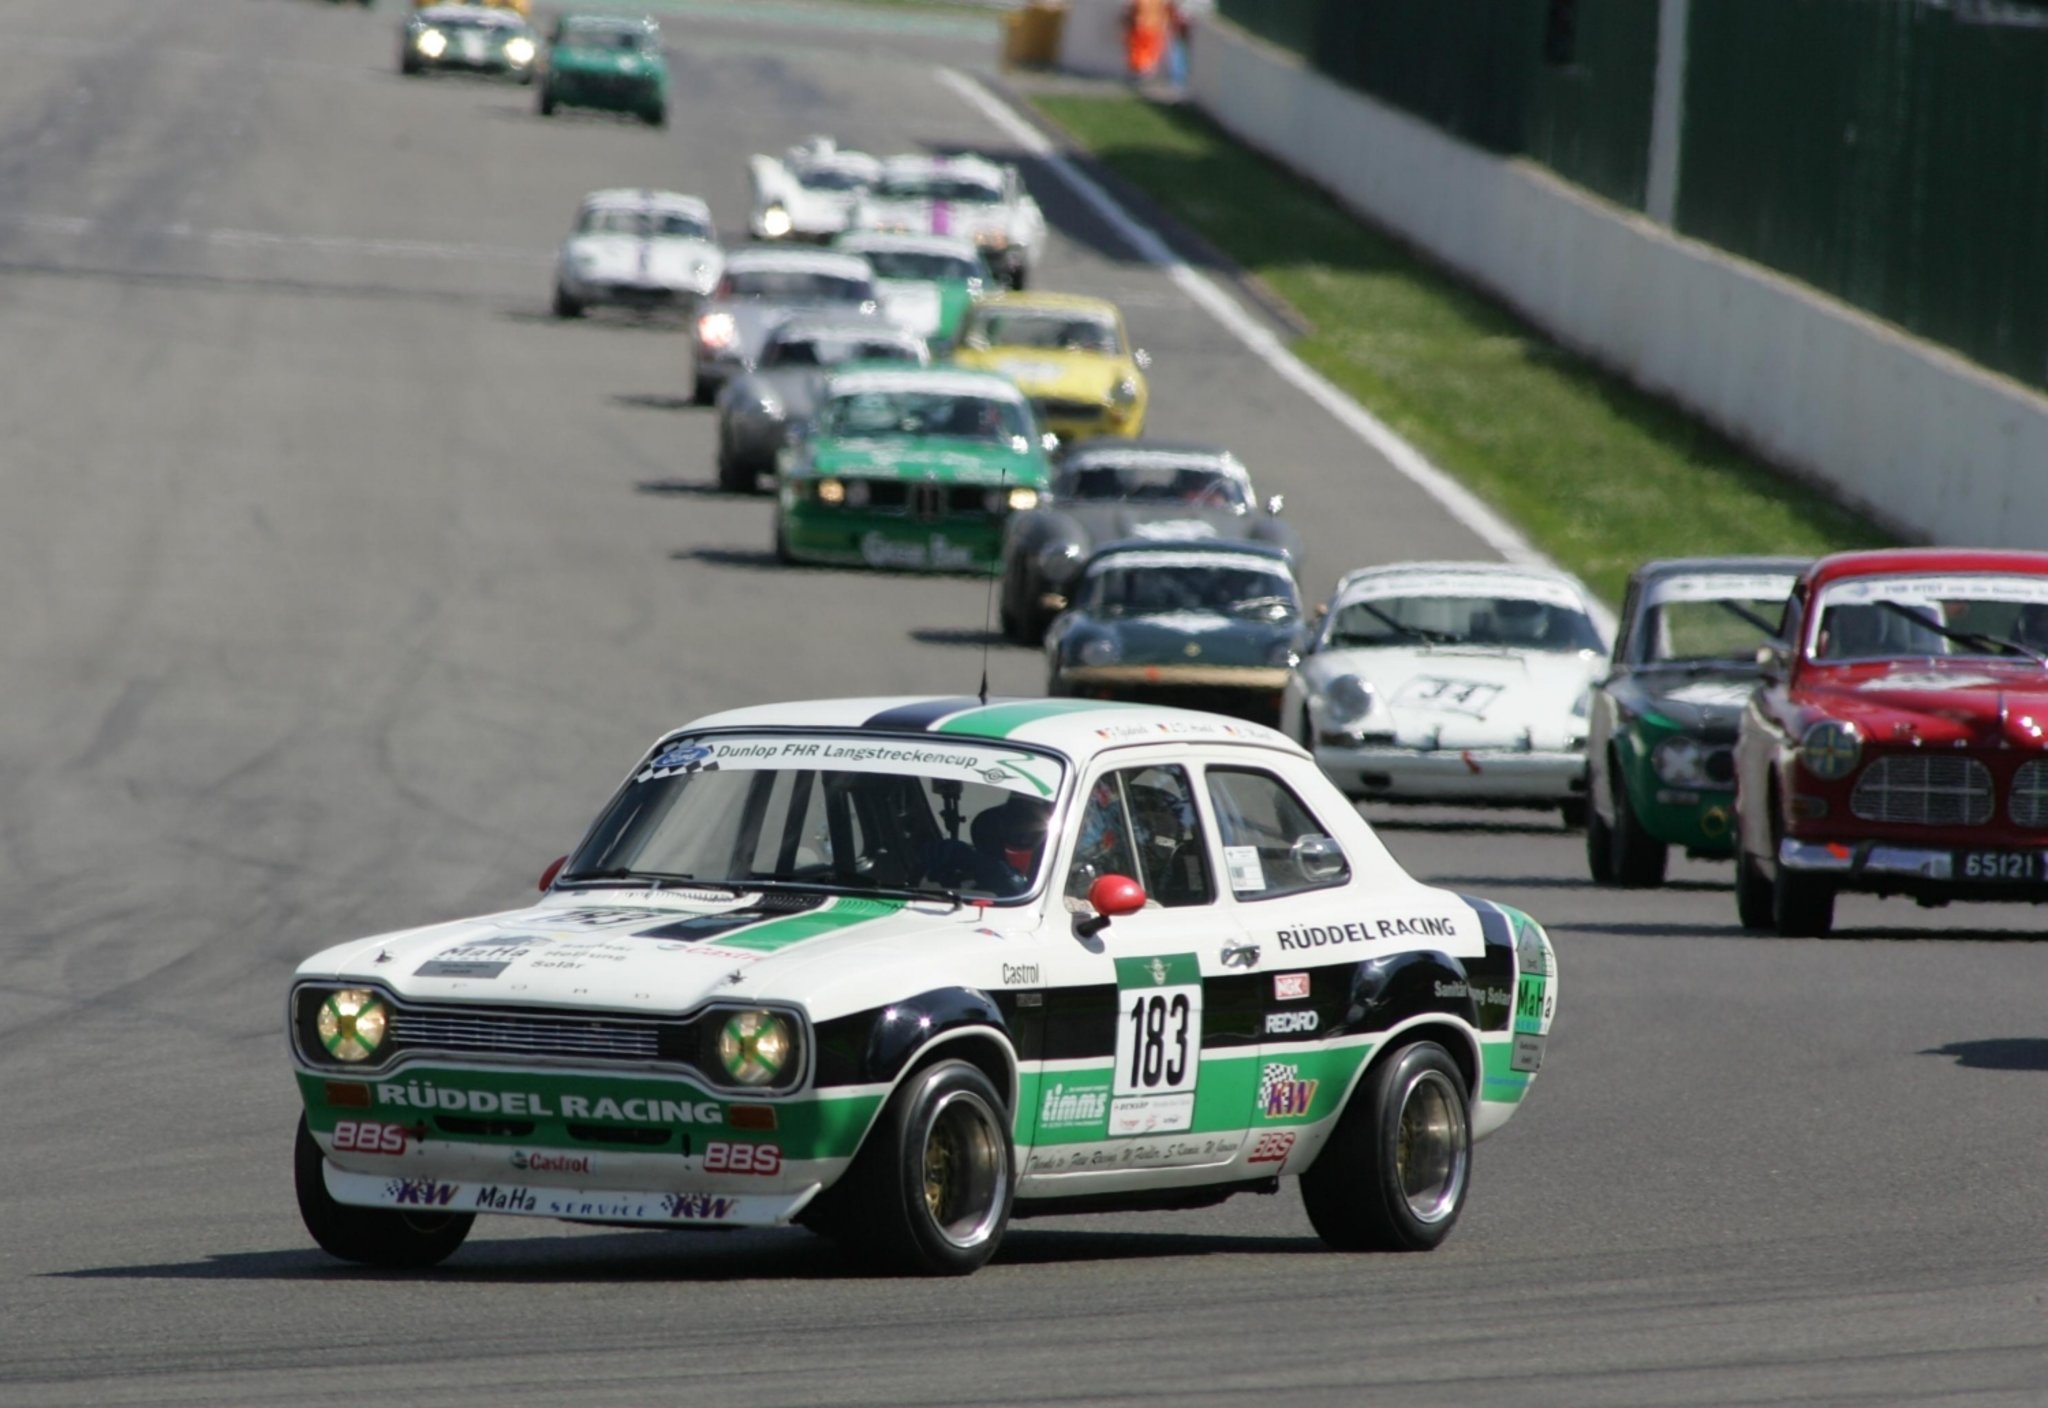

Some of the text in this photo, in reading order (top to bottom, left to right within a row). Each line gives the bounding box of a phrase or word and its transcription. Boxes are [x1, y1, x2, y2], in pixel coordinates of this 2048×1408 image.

[716, 743, 979, 769] Dunlop FHR Langstreckencup
[1965, 852, 2034, 878] 65121
[1276, 916, 1457, 951] RÜDDEL RACING
[1002, 962, 1040, 985] Castrol
[1265, 1010, 1319, 1034] RECARO
[1130, 992, 1191, 1089] 183
[375, 1078, 724, 1124] RÜDDEL RACING
[1041, 1083, 1108, 1122] timms
[1264, 1079, 1319, 1119] KW
[332, 1120, 406, 1155] BBS
[1248, 1131, 1296, 1163] BBS
[528, 1152, 591, 1174] Castrol
[704, 1141, 781, 1175] BBS
[396, 1178, 736, 1219] KW MaHa SERVICE KW
